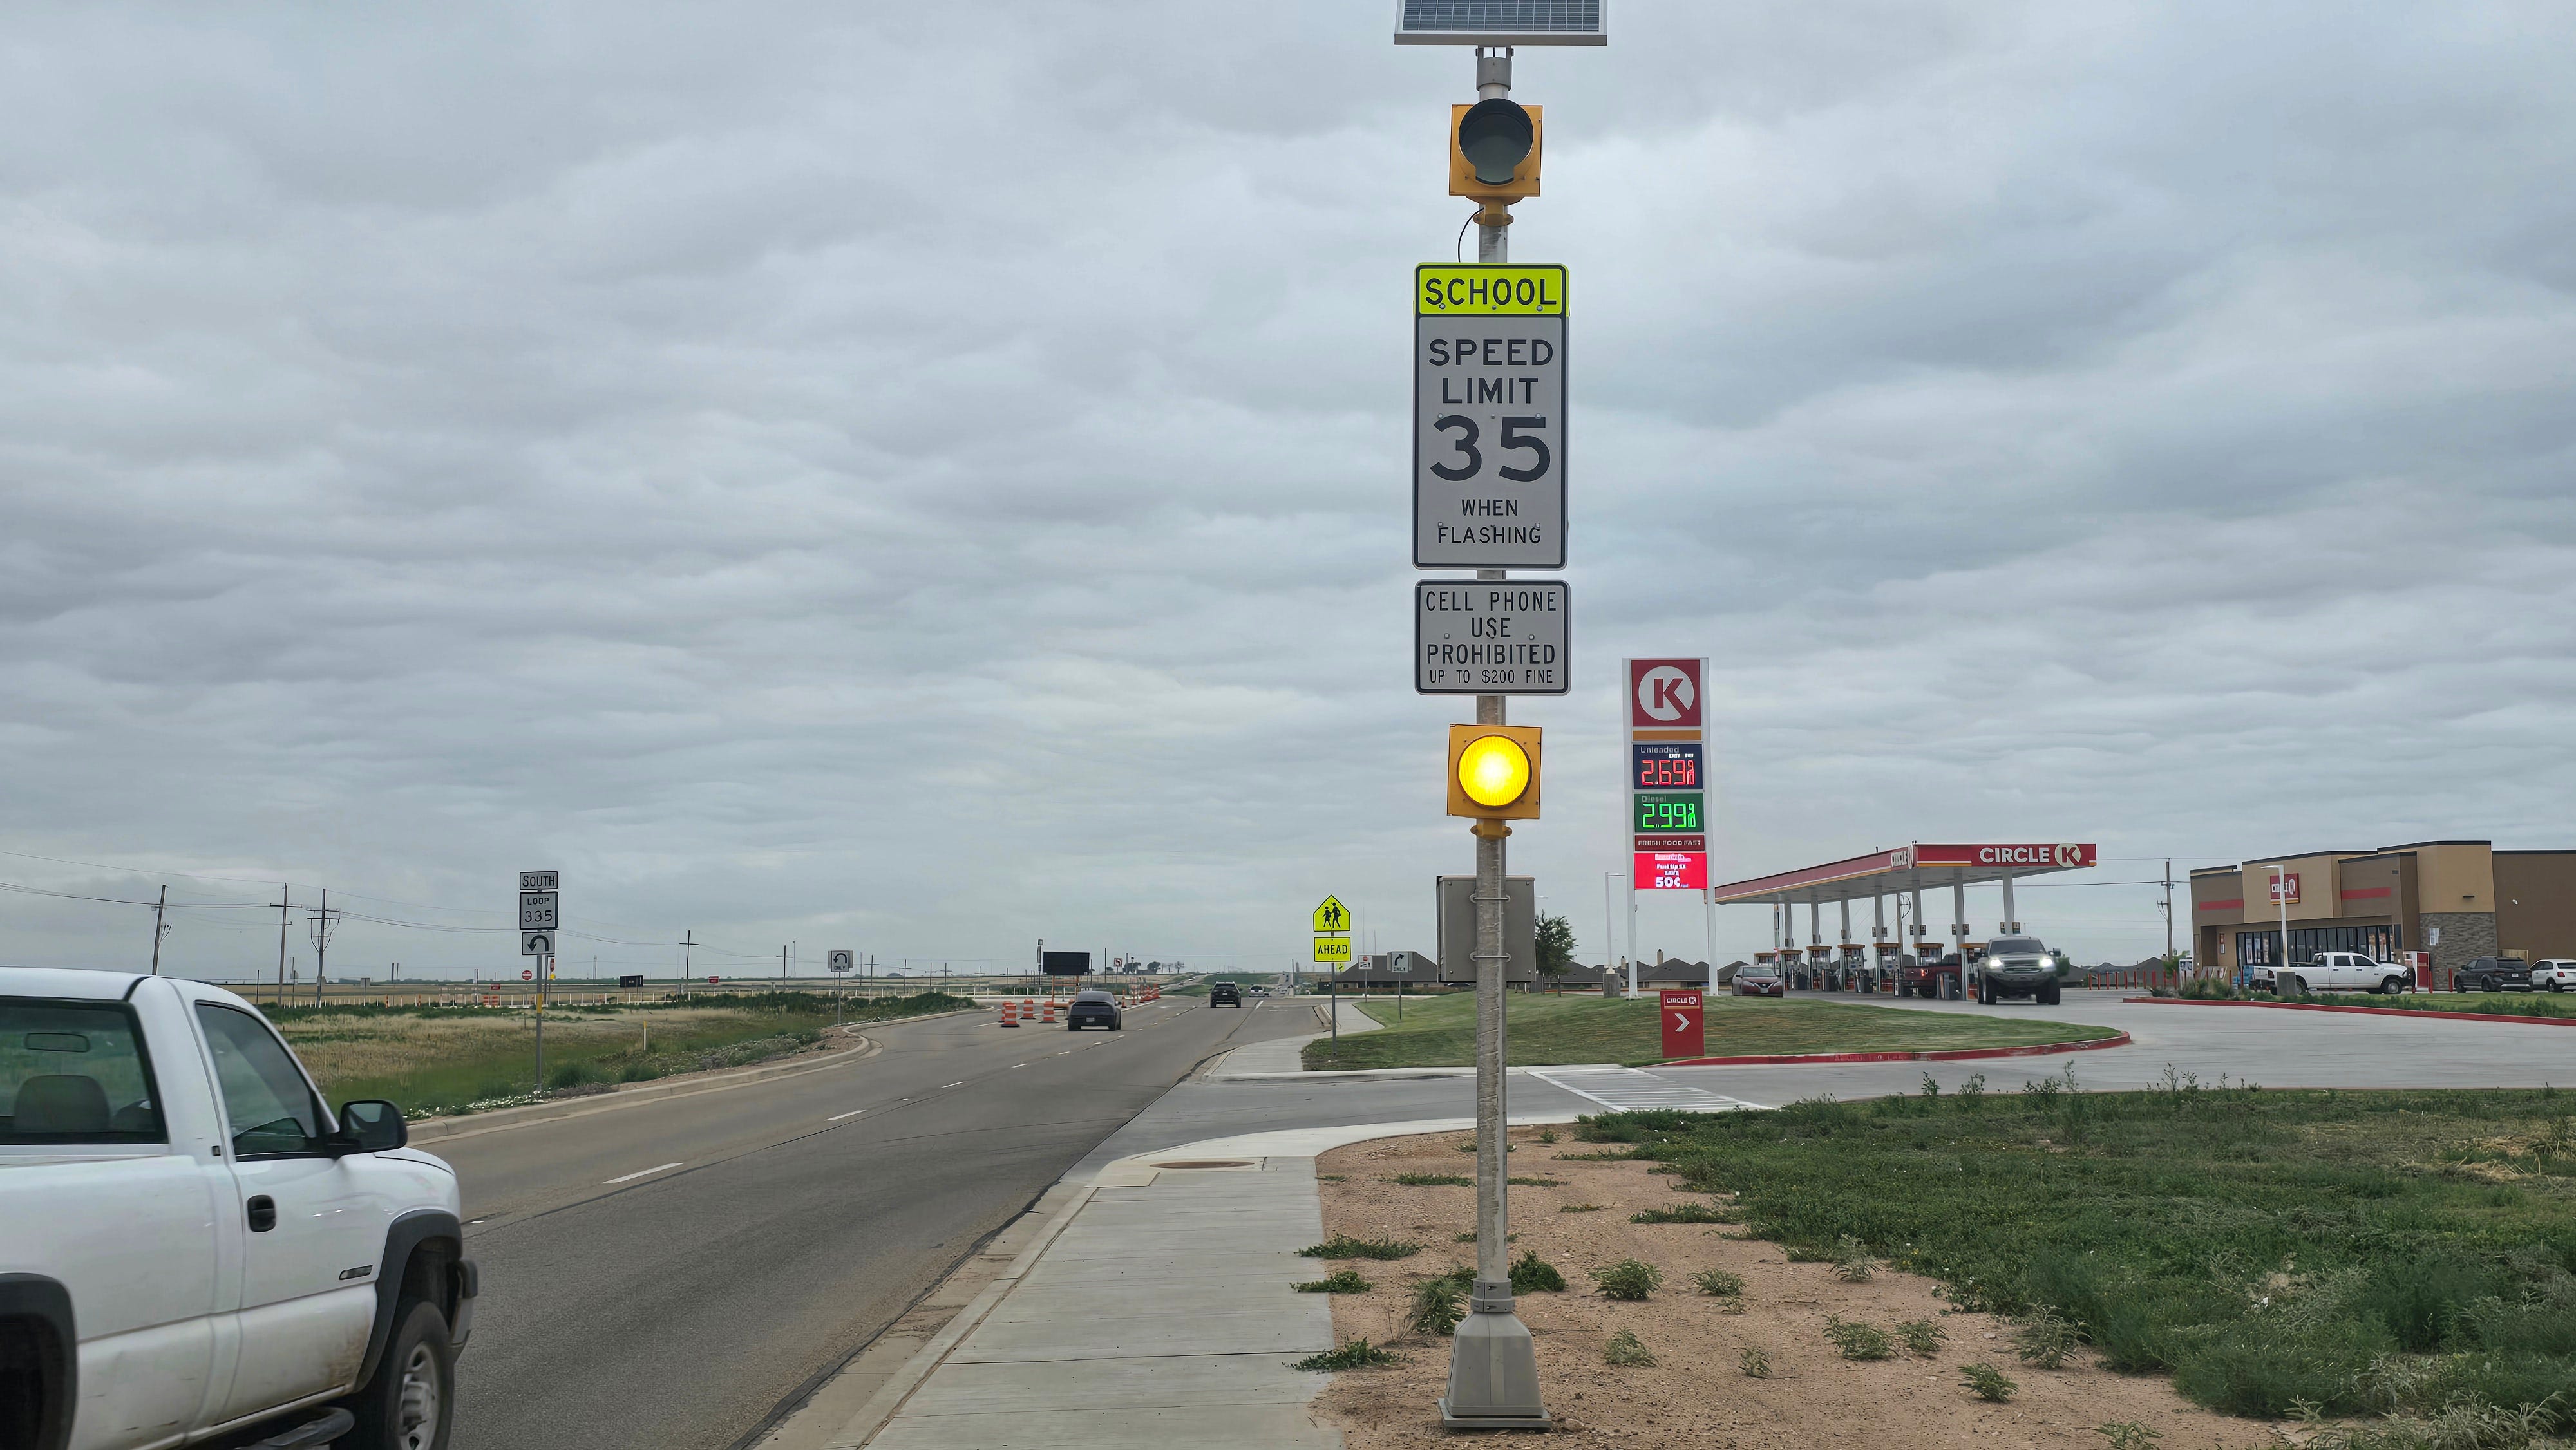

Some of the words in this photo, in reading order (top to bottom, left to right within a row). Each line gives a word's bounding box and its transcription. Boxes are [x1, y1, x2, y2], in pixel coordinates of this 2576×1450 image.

[1425, 278, 1557, 305] SCHOOL
[1428, 339, 1553, 366] SPEED
[1443, 377, 1539, 404] LIMIT
[1430, 415, 1551, 482] 35
[1461, 499, 1518, 516] WHEN
[1438, 526, 1541, 543] FLASHING
[1426, 591, 1473, 612] CELL
[1490, 591, 1556, 612] PHONE
[1472, 617, 1511, 639] USE
[1427, 644, 1555, 664] PROHIBITED
[1430, 670, 1445, 683] UP
[1456, 670, 1470, 683] TO
[1481, 669, 1515, 684] $200
[1526, 670, 1553, 683] FINE
[1652, 676, 1690, 718] K
[1979, 847, 2050, 863] CIRCLE
[2061, 846, 2079, 867] K
[522, 875, 555, 887] SOUTH
[1656, 876, 1680, 887] 50¢
[524, 910, 553, 922] 335
[1318, 945, 1347, 954] AHEAD
